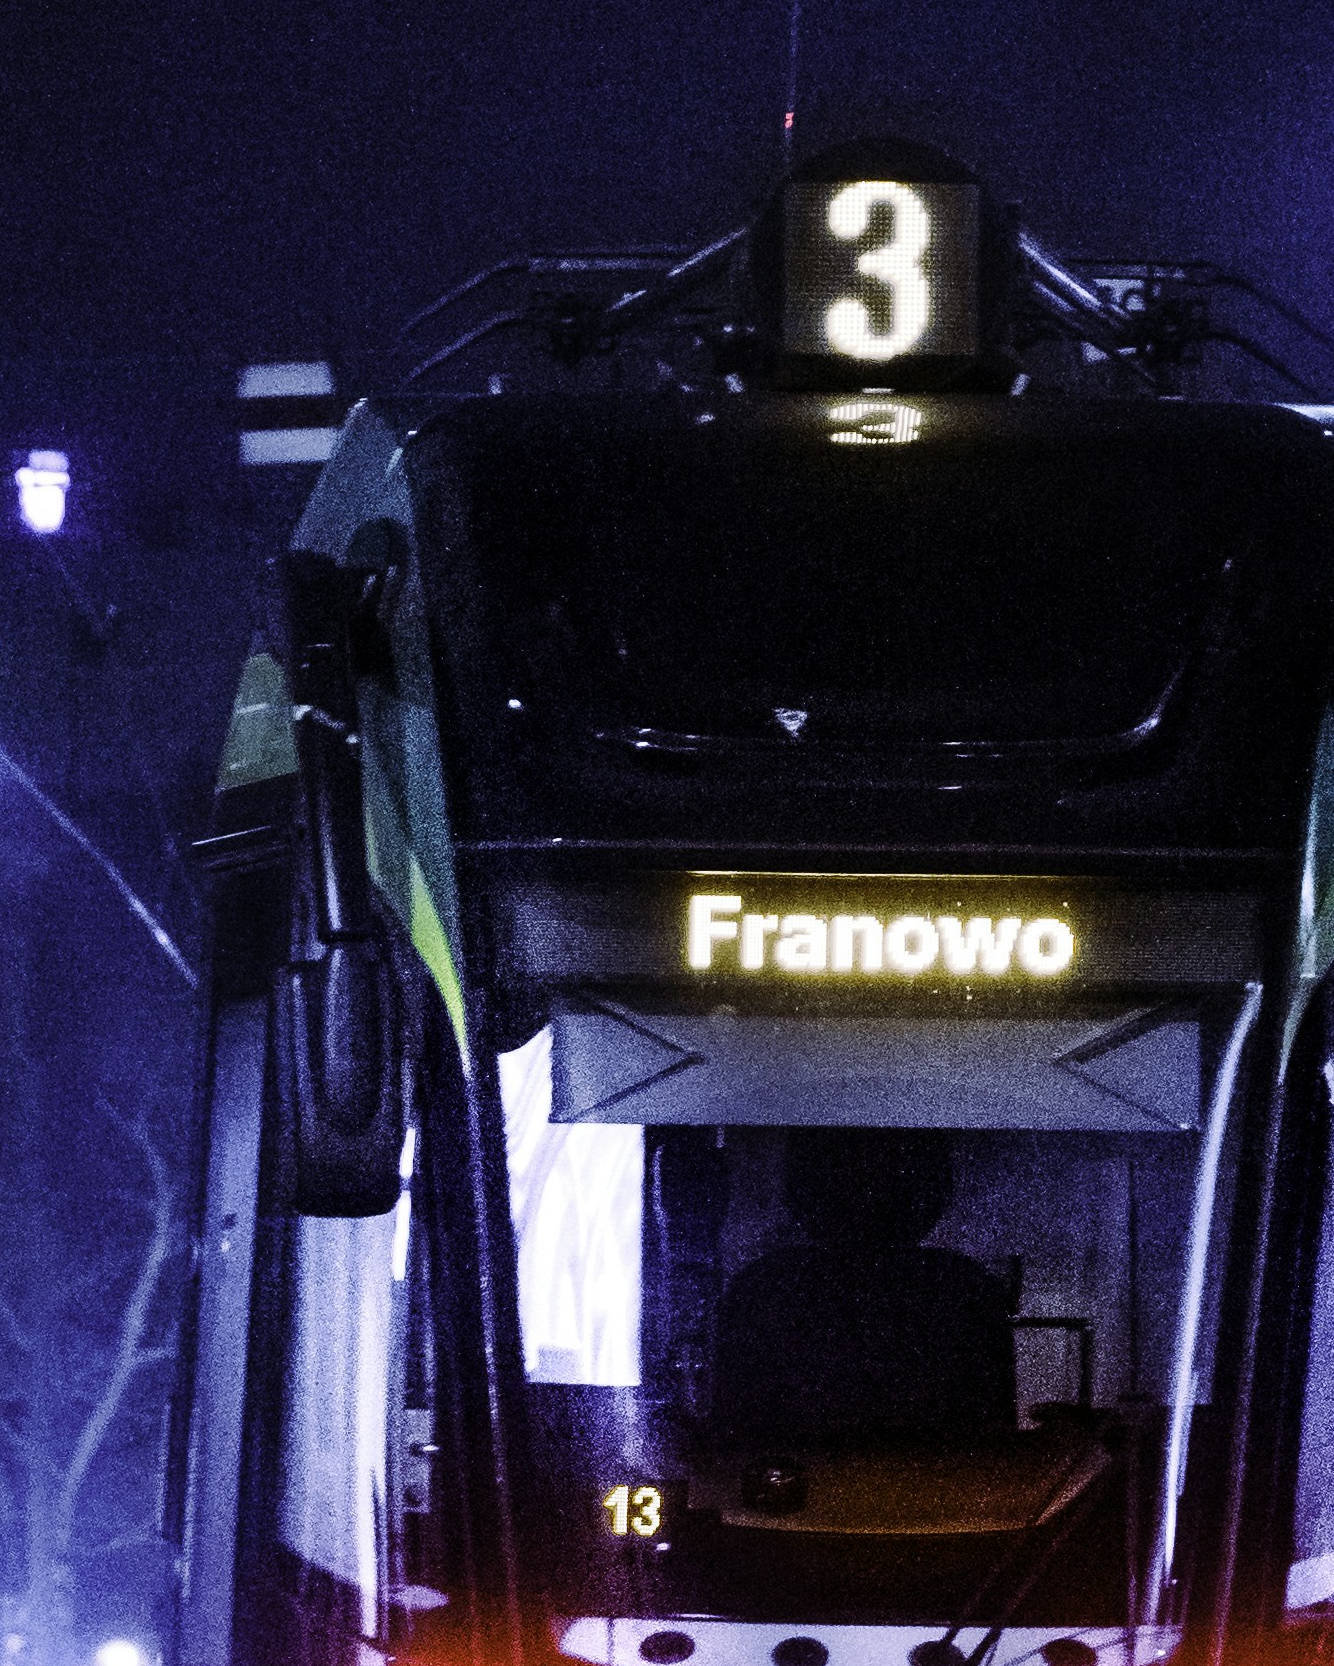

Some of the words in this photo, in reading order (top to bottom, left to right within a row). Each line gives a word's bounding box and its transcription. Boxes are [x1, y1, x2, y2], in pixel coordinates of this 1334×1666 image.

[827, 181, 929, 360] 3
[689, 894, 1075, 974] Franowo
[603, 1484, 663, 1537] 13
